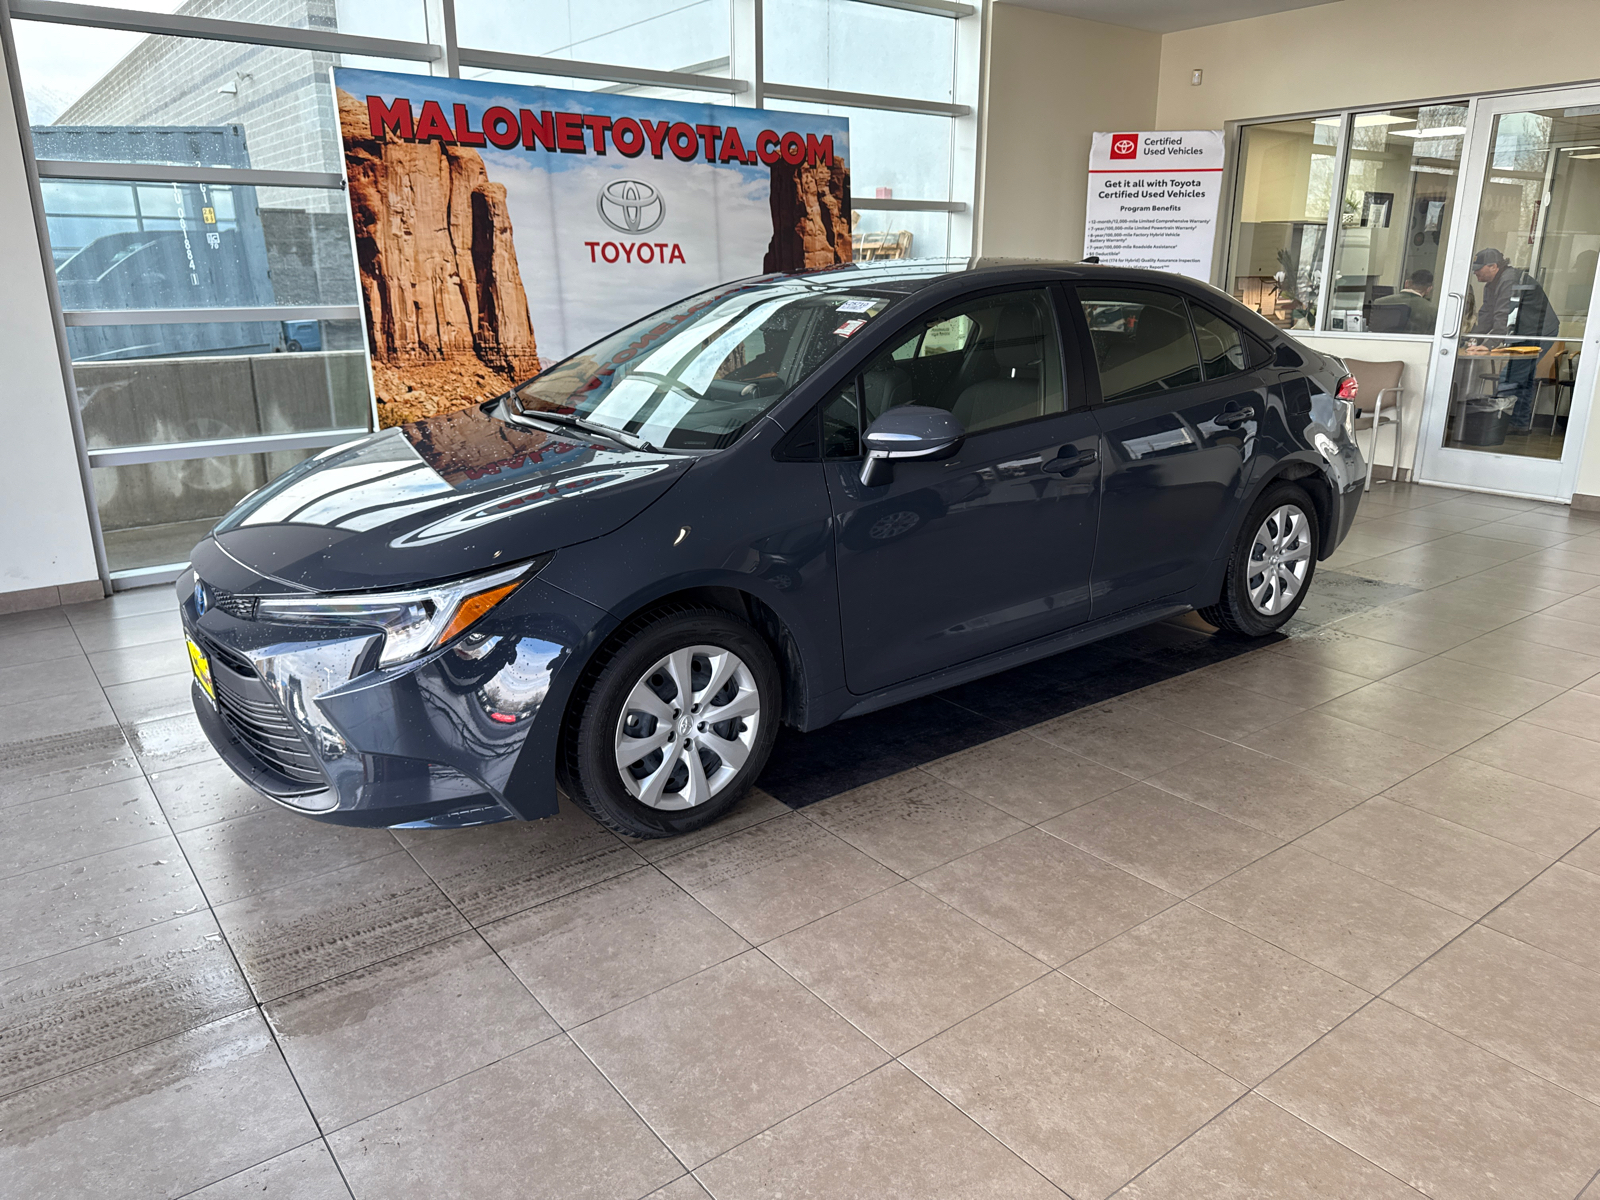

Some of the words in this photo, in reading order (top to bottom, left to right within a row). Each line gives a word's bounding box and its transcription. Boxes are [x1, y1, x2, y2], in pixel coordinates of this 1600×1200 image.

[366, 95, 834, 167] MALONETOYOTA.COM
[1144, 137, 1183, 146] Certified
[1143, 148, 1166, 156] Used
[1167, 147, 1204, 156] Vehicles
[1104, 180, 1122, 188] Get
[1123, 179, 1131, 188] it
[1132, 179, 1145, 188] all
[1146, 179, 1168, 188] with
[1169, 179, 1202, 189] Toyota
[1098, 190, 1140, 199] Certified
[1141, 190, 1165, 198] Used
[1166, 189, 1206, 198] Vehicles
[1120, 205, 1151, 213] Program
[1151, 204, 1182, 212] Benefits
[584, 241, 686, 265] TOYOTA
